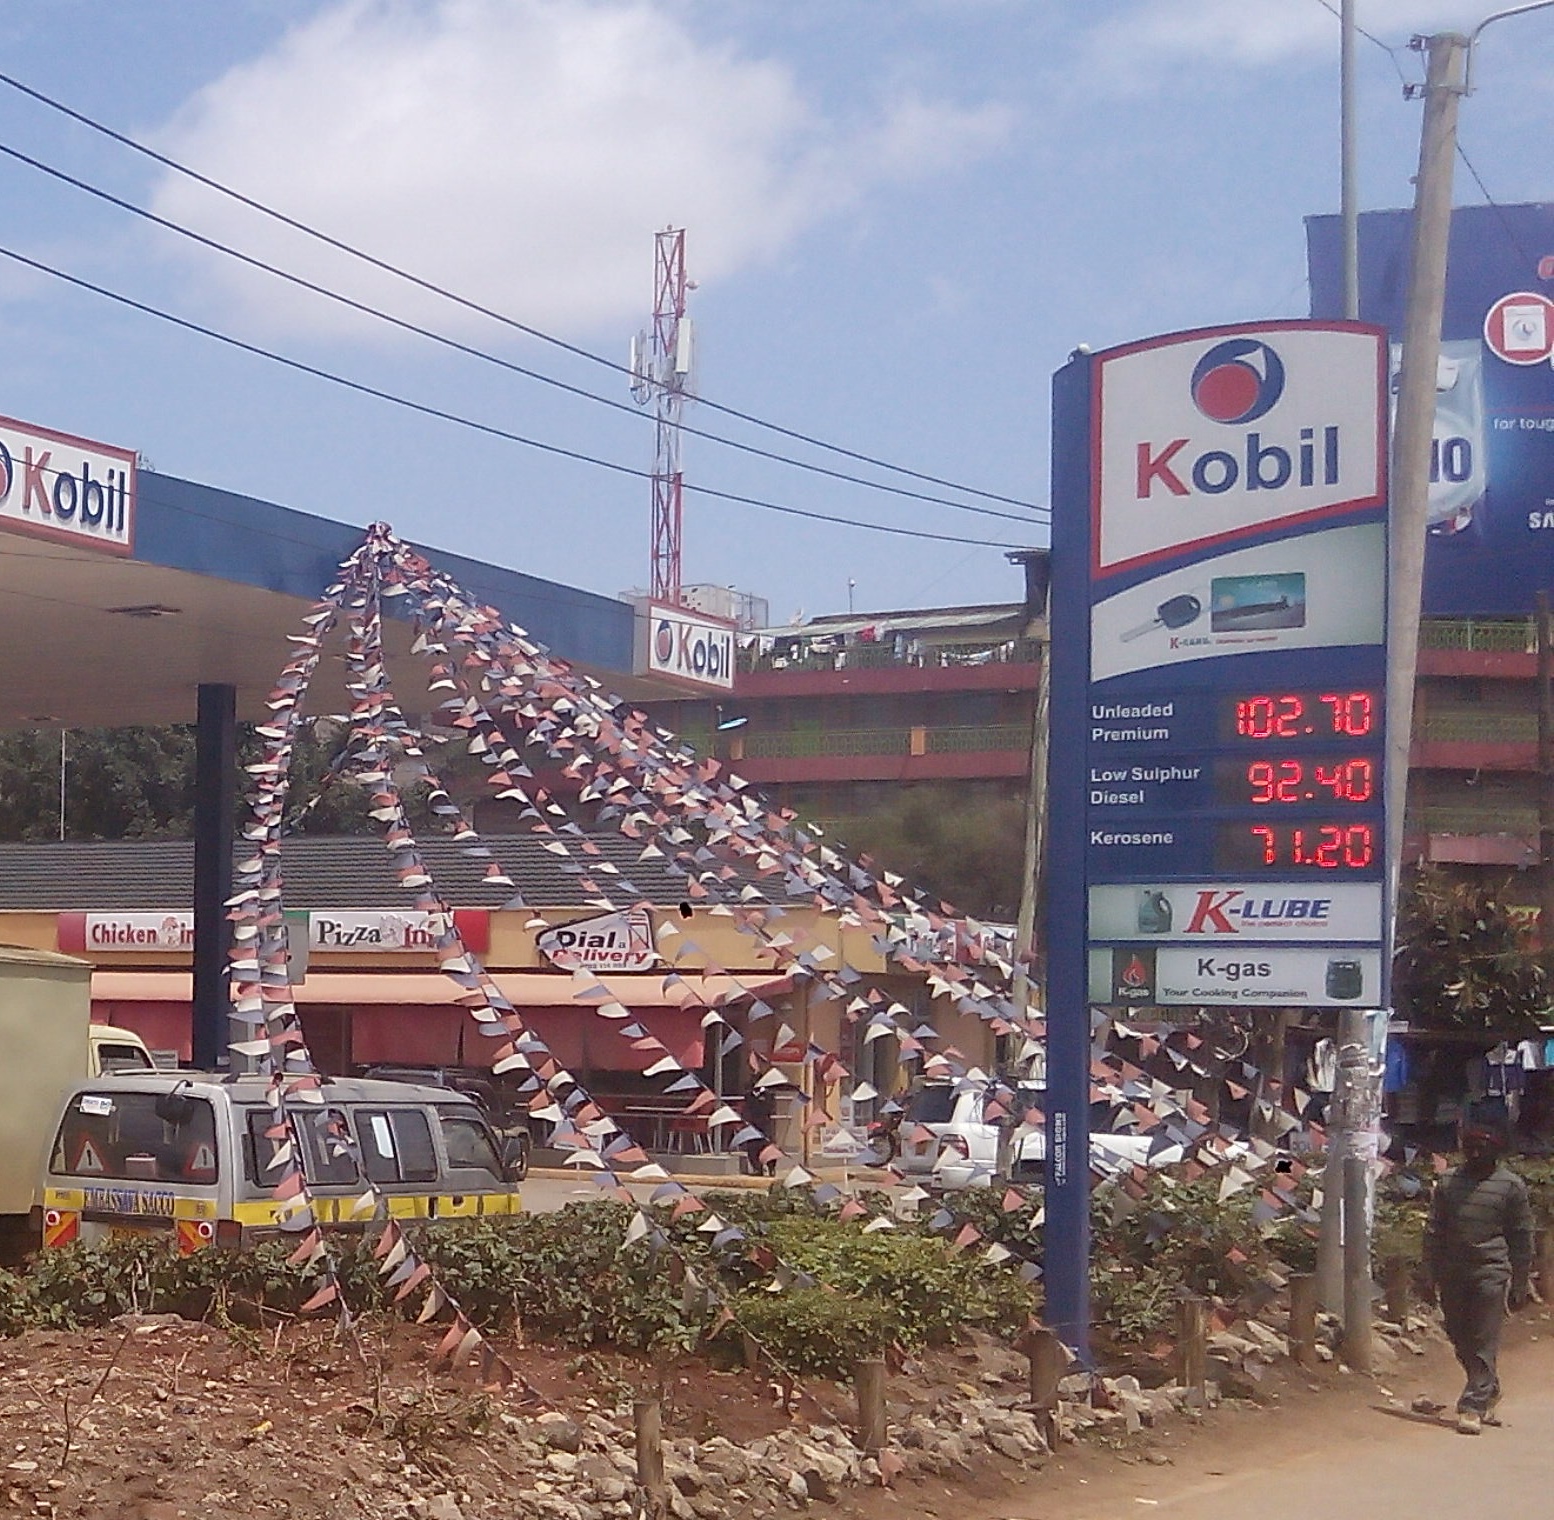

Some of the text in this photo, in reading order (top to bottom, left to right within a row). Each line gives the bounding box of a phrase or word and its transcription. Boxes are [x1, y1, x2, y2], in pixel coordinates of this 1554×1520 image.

[1136, 425, 1339, 499] Kobil
[22, 446, 126, 533] Kobil
[676, 622, 731, 680] Kobil
[1091, 703, 1174, 720] Unleaded
[1236, 692, 1372, 739] 102.70
[1091, 726, 1169, 743] Premium
[1090, 766, 1201, 785] Low Sulphur
[1247, 760, 1372, 803] 92.40
[1090, 789, 1145, 805] Diesel
[1090, 830, 1174, 846] Kerosene
[1250, 825, 1372, 868] 71.20
[1183, 890, 1333, 934] K-LUBE
[92, 922, 158, 944] Chicken
[317, 919, 382, 947] Pizza
[556, 930, 617, 949] Dial
[1197, 958, 1272, 982] K-gas
[1163, 987, 1308, 1000] Your Cooking Companion
